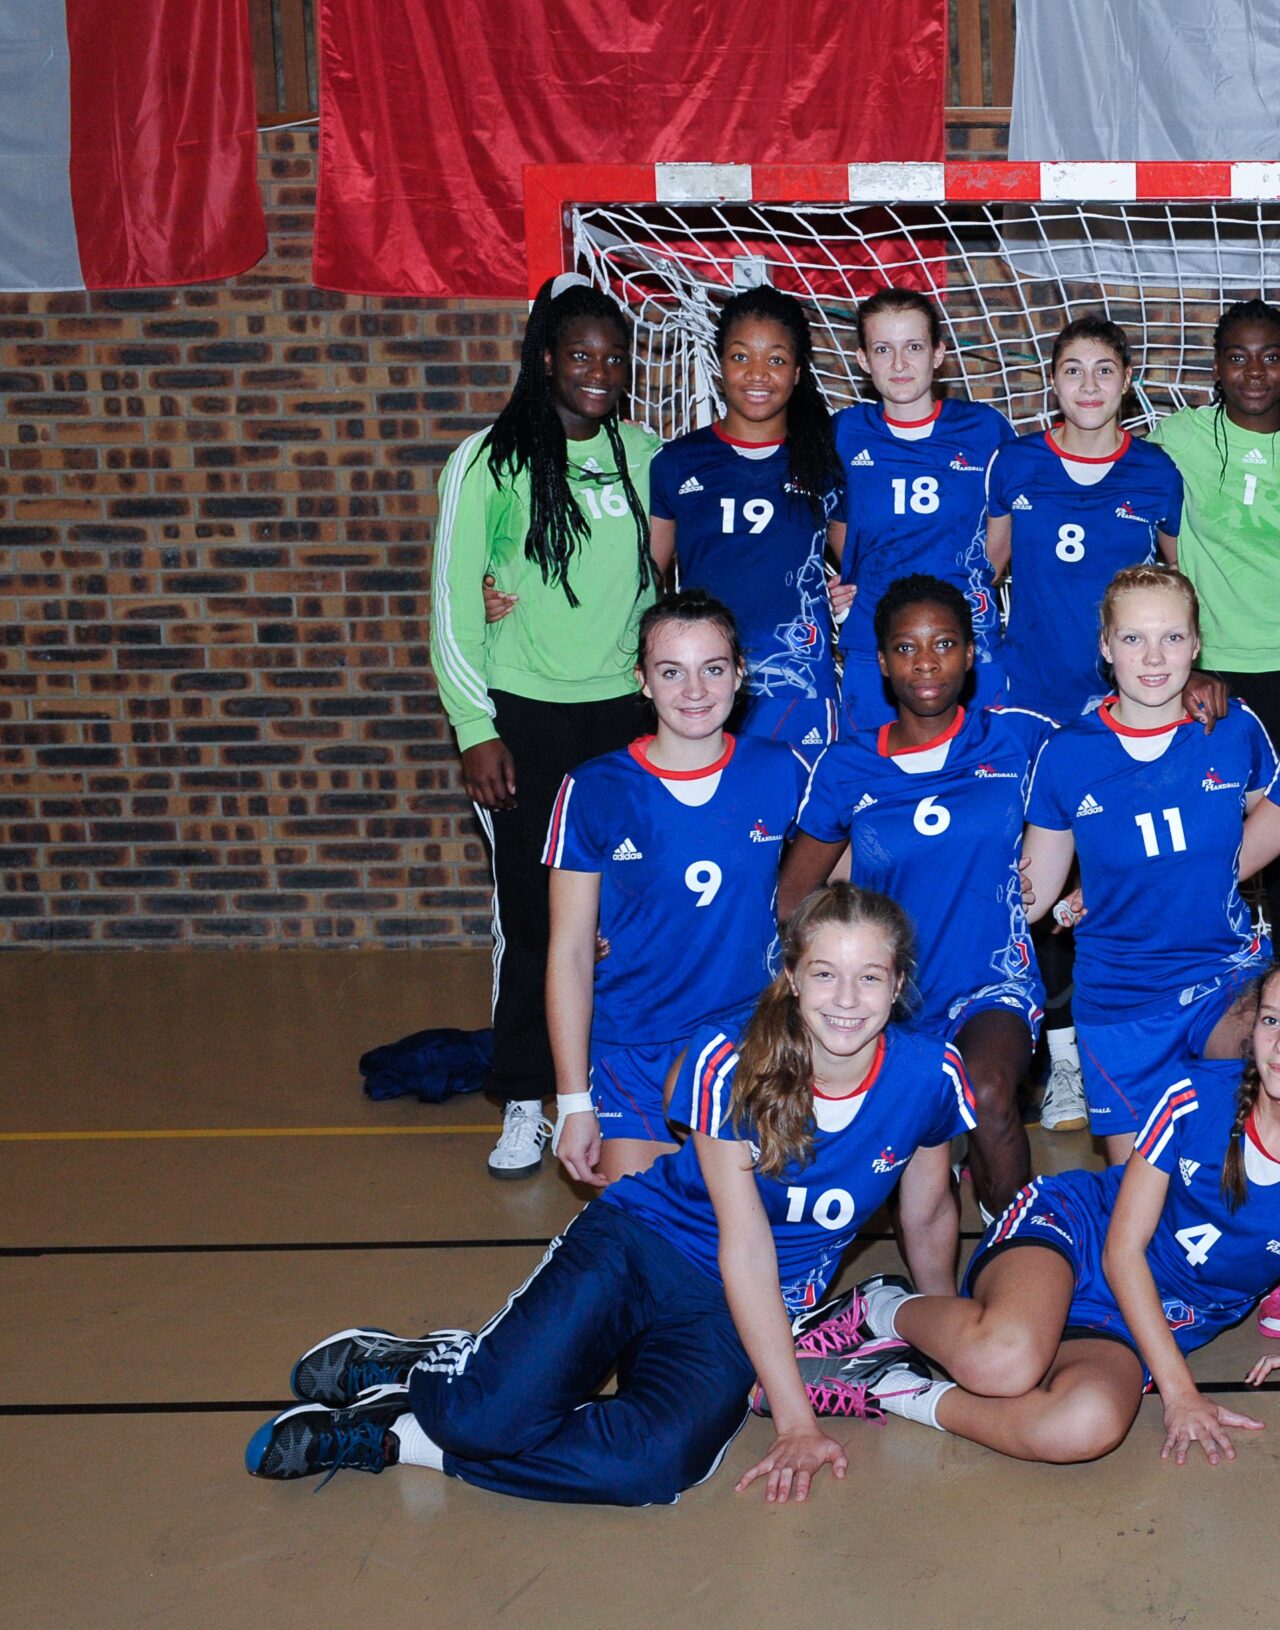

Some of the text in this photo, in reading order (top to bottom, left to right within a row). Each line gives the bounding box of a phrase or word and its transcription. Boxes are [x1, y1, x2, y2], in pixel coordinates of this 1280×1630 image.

[579, 484, 629, 519] 16
[891, 475, 940, 515] 18
[1243, 473, 1257, 506] 1
[720, 498, 774, 534] 19
[1055, 523, 1085, 563] 8
[913, 795, 950, 836] 6
[1135, 807, 1187, 858] 11
[684, 860, 722, 908] 9
[786, 1186, 855, 1231] 10
[1175, 1223, 1222, 1267] 4
